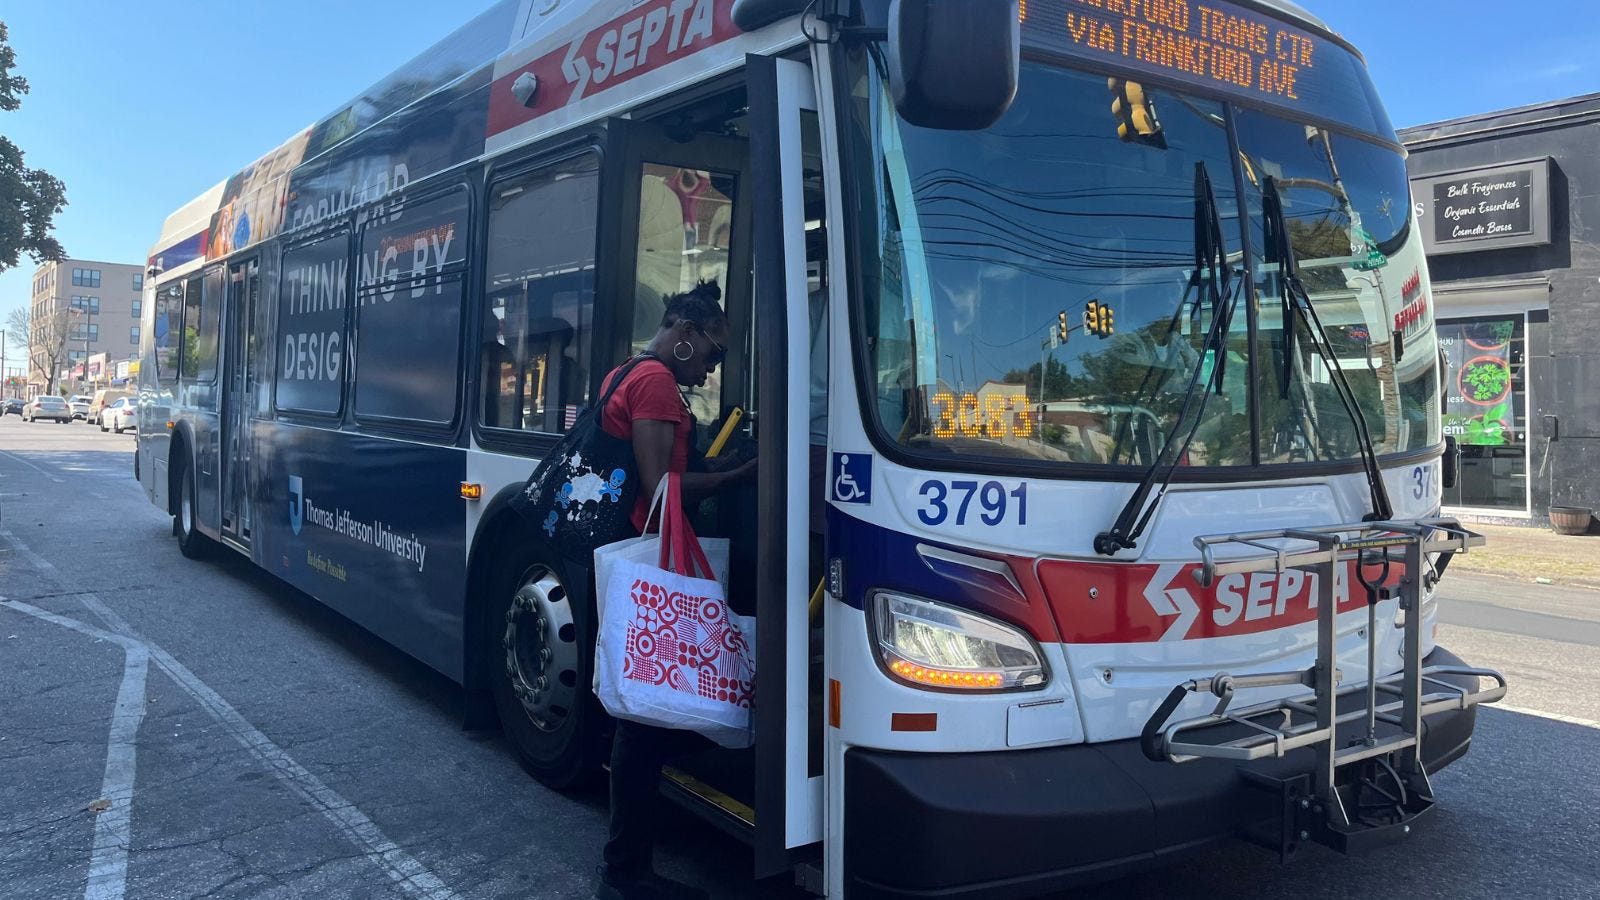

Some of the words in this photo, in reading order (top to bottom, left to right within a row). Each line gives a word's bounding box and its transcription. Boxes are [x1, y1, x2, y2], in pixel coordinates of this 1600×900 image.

[592, 0, 714, 84] SEPTA
[1067, 12, 1115, 52] VIA
[1122, 19, 1252, 88] FRANKFORD
[1259, 58, 1299, 99] AVE
[1198, 5, 1268, 55] TRANS
[1275, 30, 1313, 68] CTR
[1444, 206, 1476, 221] Organic
[1478, 197, 1520, 214] Essentials
[1447, 183, 1468, 197] Bulk
[1471, 181, 1516, 196] Fragrances
[1452, 225, 1484, 238] Cosmetic
[411, 228, 455, 298] BY
[932, 392, 1032, 438] 3083
[1443, 425, 1464, 435] em
[917, 479, 1027, 526] 3791
[305, 498, 334, 530] Thomas
[335, 507, 373, 545] Jefferson
[374, 520, 426, 572] University
[1212, 561, 1350, 627] SEPTA
